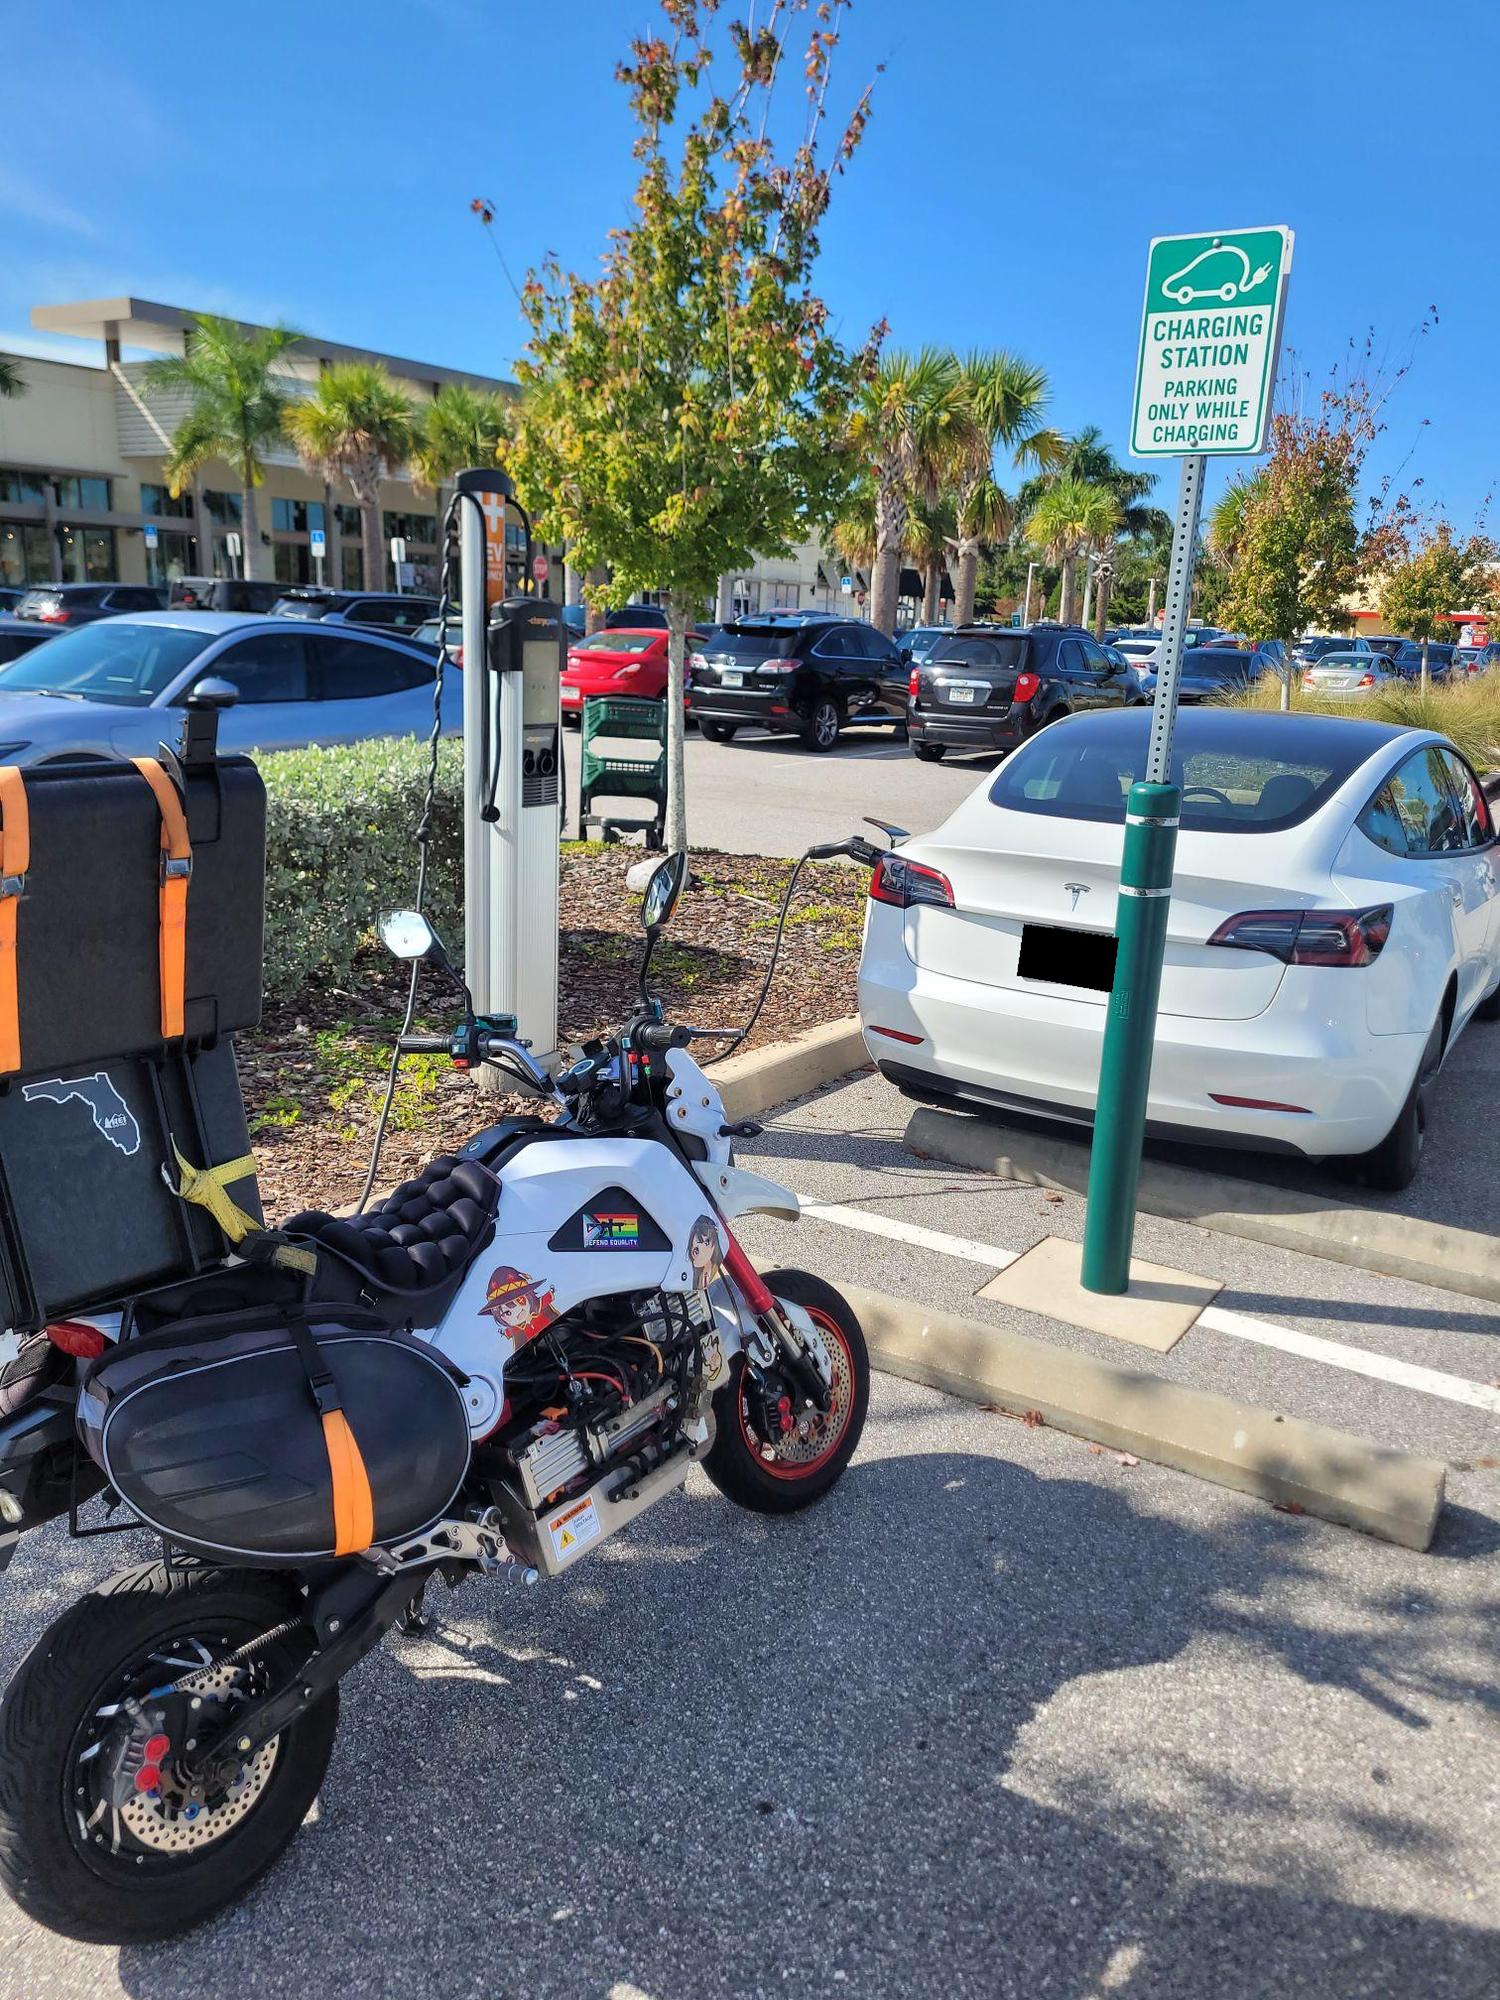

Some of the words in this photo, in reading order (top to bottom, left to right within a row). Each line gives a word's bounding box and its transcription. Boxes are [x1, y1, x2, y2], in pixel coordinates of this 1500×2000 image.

[1153, 313, 1263, 341] CHARGING
[1160, 343, 1249, 369] STATION
[1164, 377, 1238, 398] PARKING
[1148, 402, 1190, 421] ONLY
[1195, 400, 1250, 419] WHILE
[1153, 423, 1239, 443] CHARGING
[487, 542, 502, 562] EV
[533, 563, 548, 574] STOP
